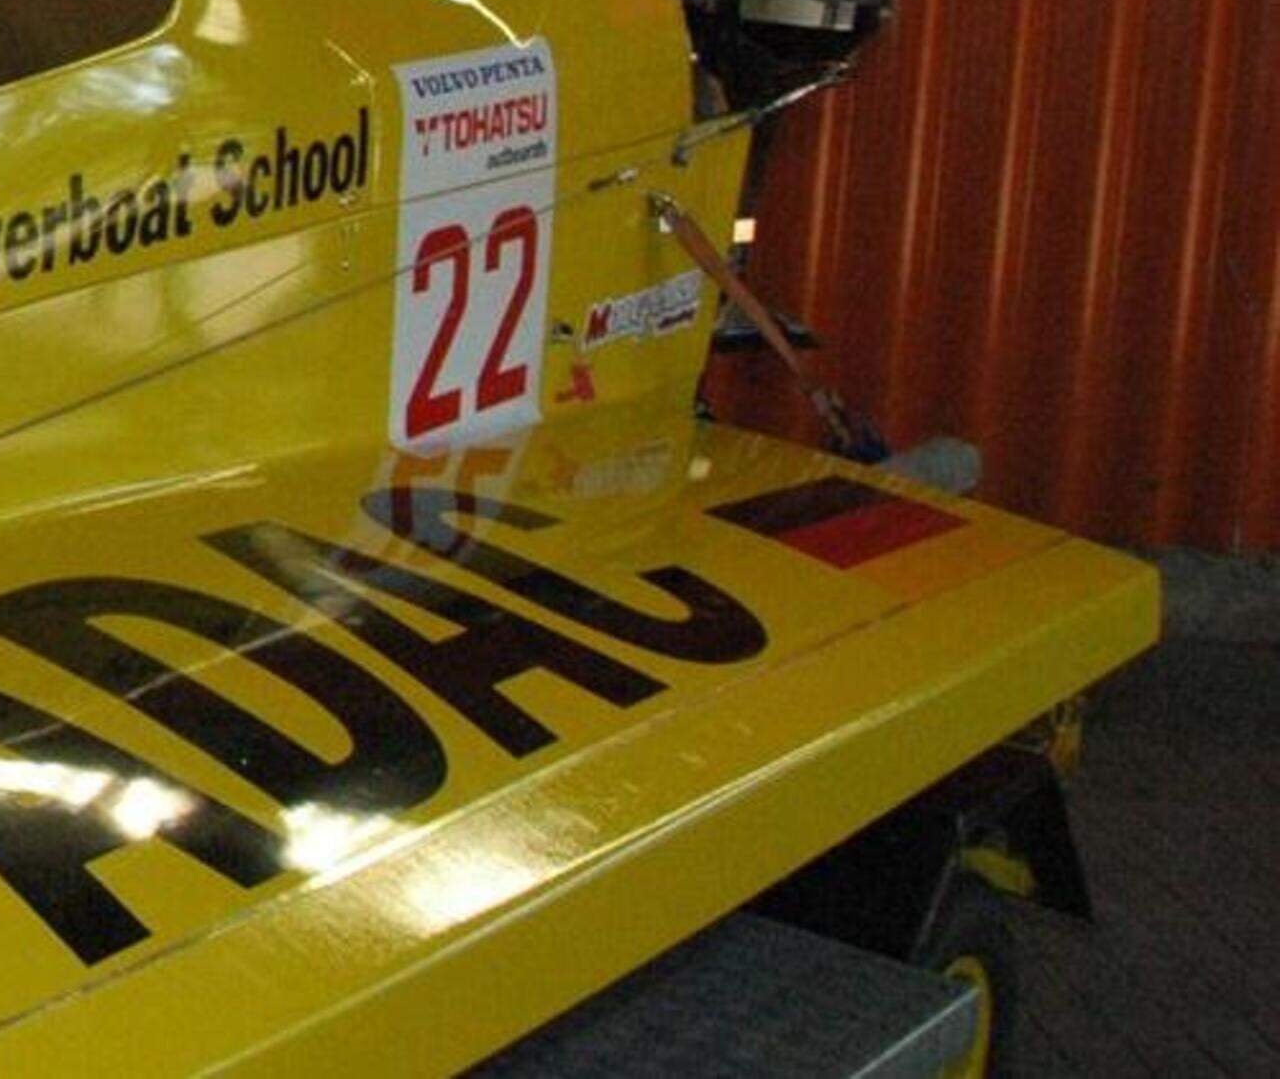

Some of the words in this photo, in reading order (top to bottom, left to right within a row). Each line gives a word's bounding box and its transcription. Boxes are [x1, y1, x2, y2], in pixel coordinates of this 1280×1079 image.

[412, 67, 479, 98] VOLVO
[479, 56, 545, 86] PENTA
[440, 92, 548, 152] TOHATSU
[210, 107, 370, 227] School
[405, 204, 538, 439] 22
